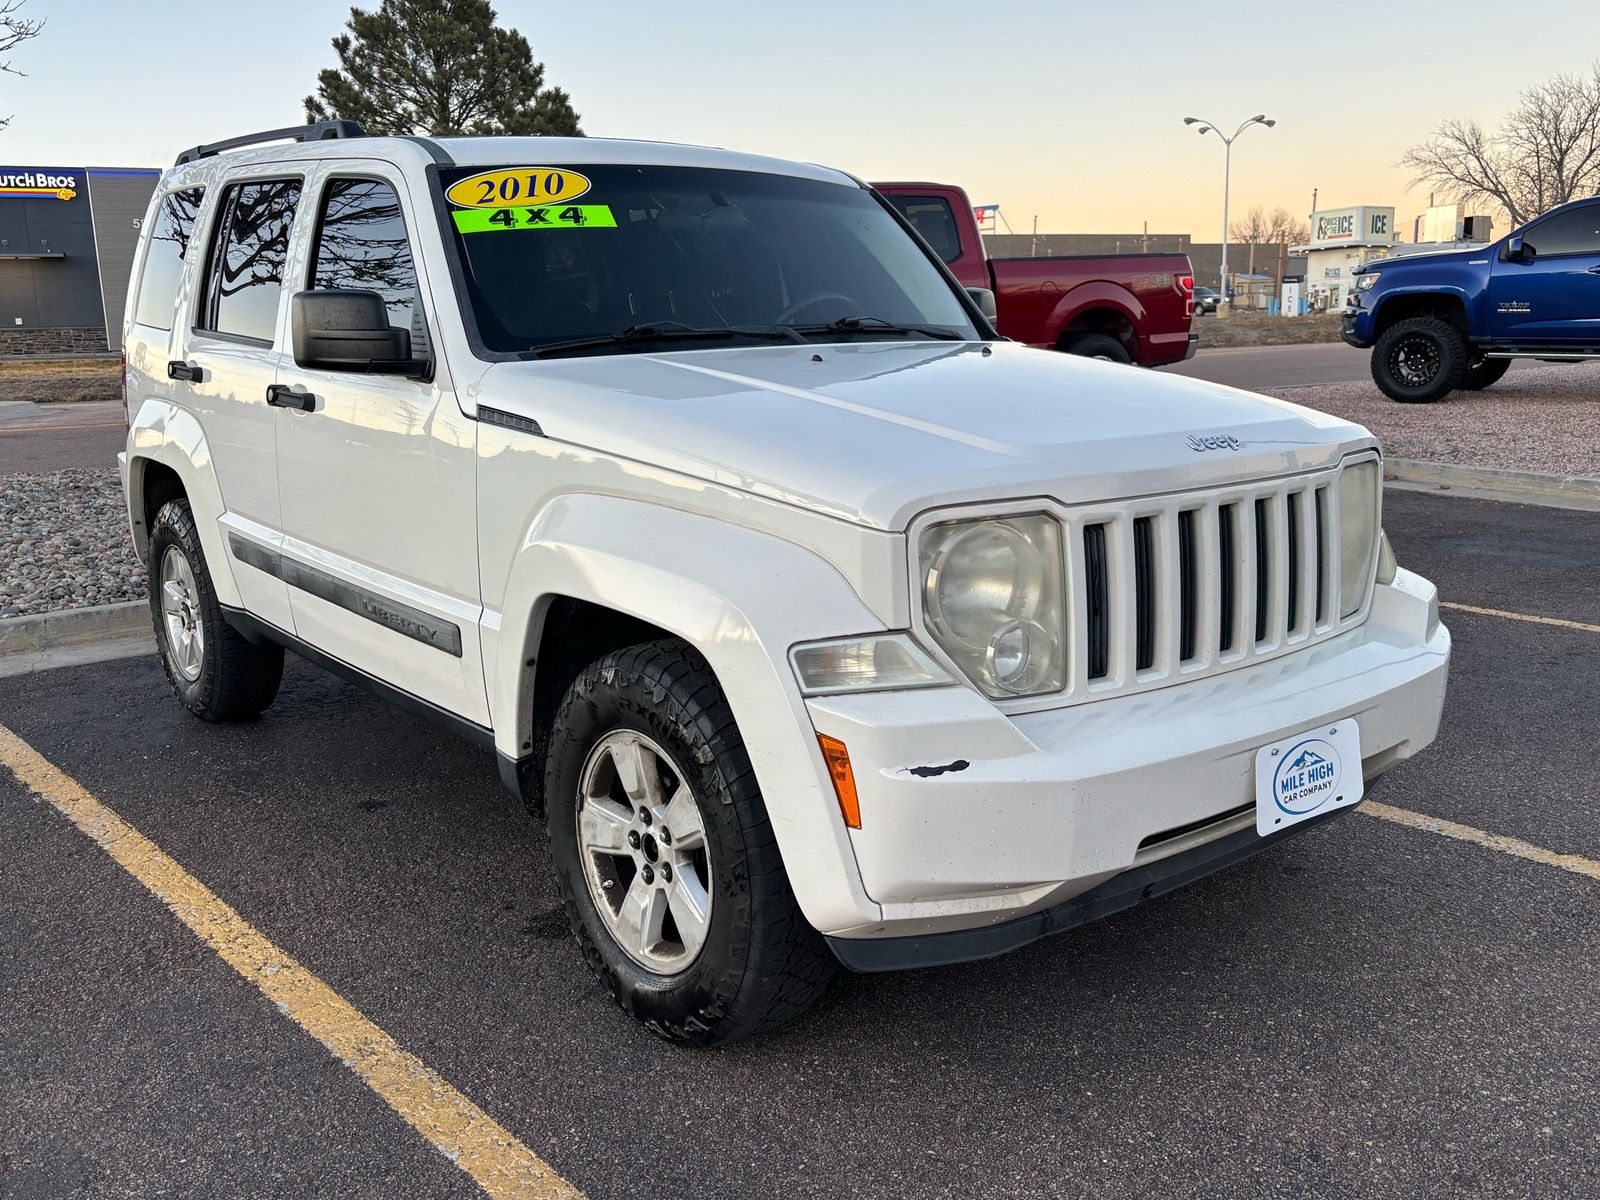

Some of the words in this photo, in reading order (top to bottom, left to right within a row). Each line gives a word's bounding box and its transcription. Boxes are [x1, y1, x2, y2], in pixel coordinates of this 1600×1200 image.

[0, 172, 36, 188] UTCH
[36, 173, 76, 188] BROS
[476, 172, 565, 205] 2010
[132, 218, 145, 229] 5
[1337, 215, 1353, 234] ICE
[1371, 214, 1387, 234] ICE
[1186, 434, 1240, 452] Jeep
[362, 598, 438, 641] LIBERTY
[1280, 772, 1305, 795] MILE
[1308, 762, 1334, 784] HIGH
[1283, 792, 1298, 805] CAR
[1299, 780, 1333, 799] COMPANY
